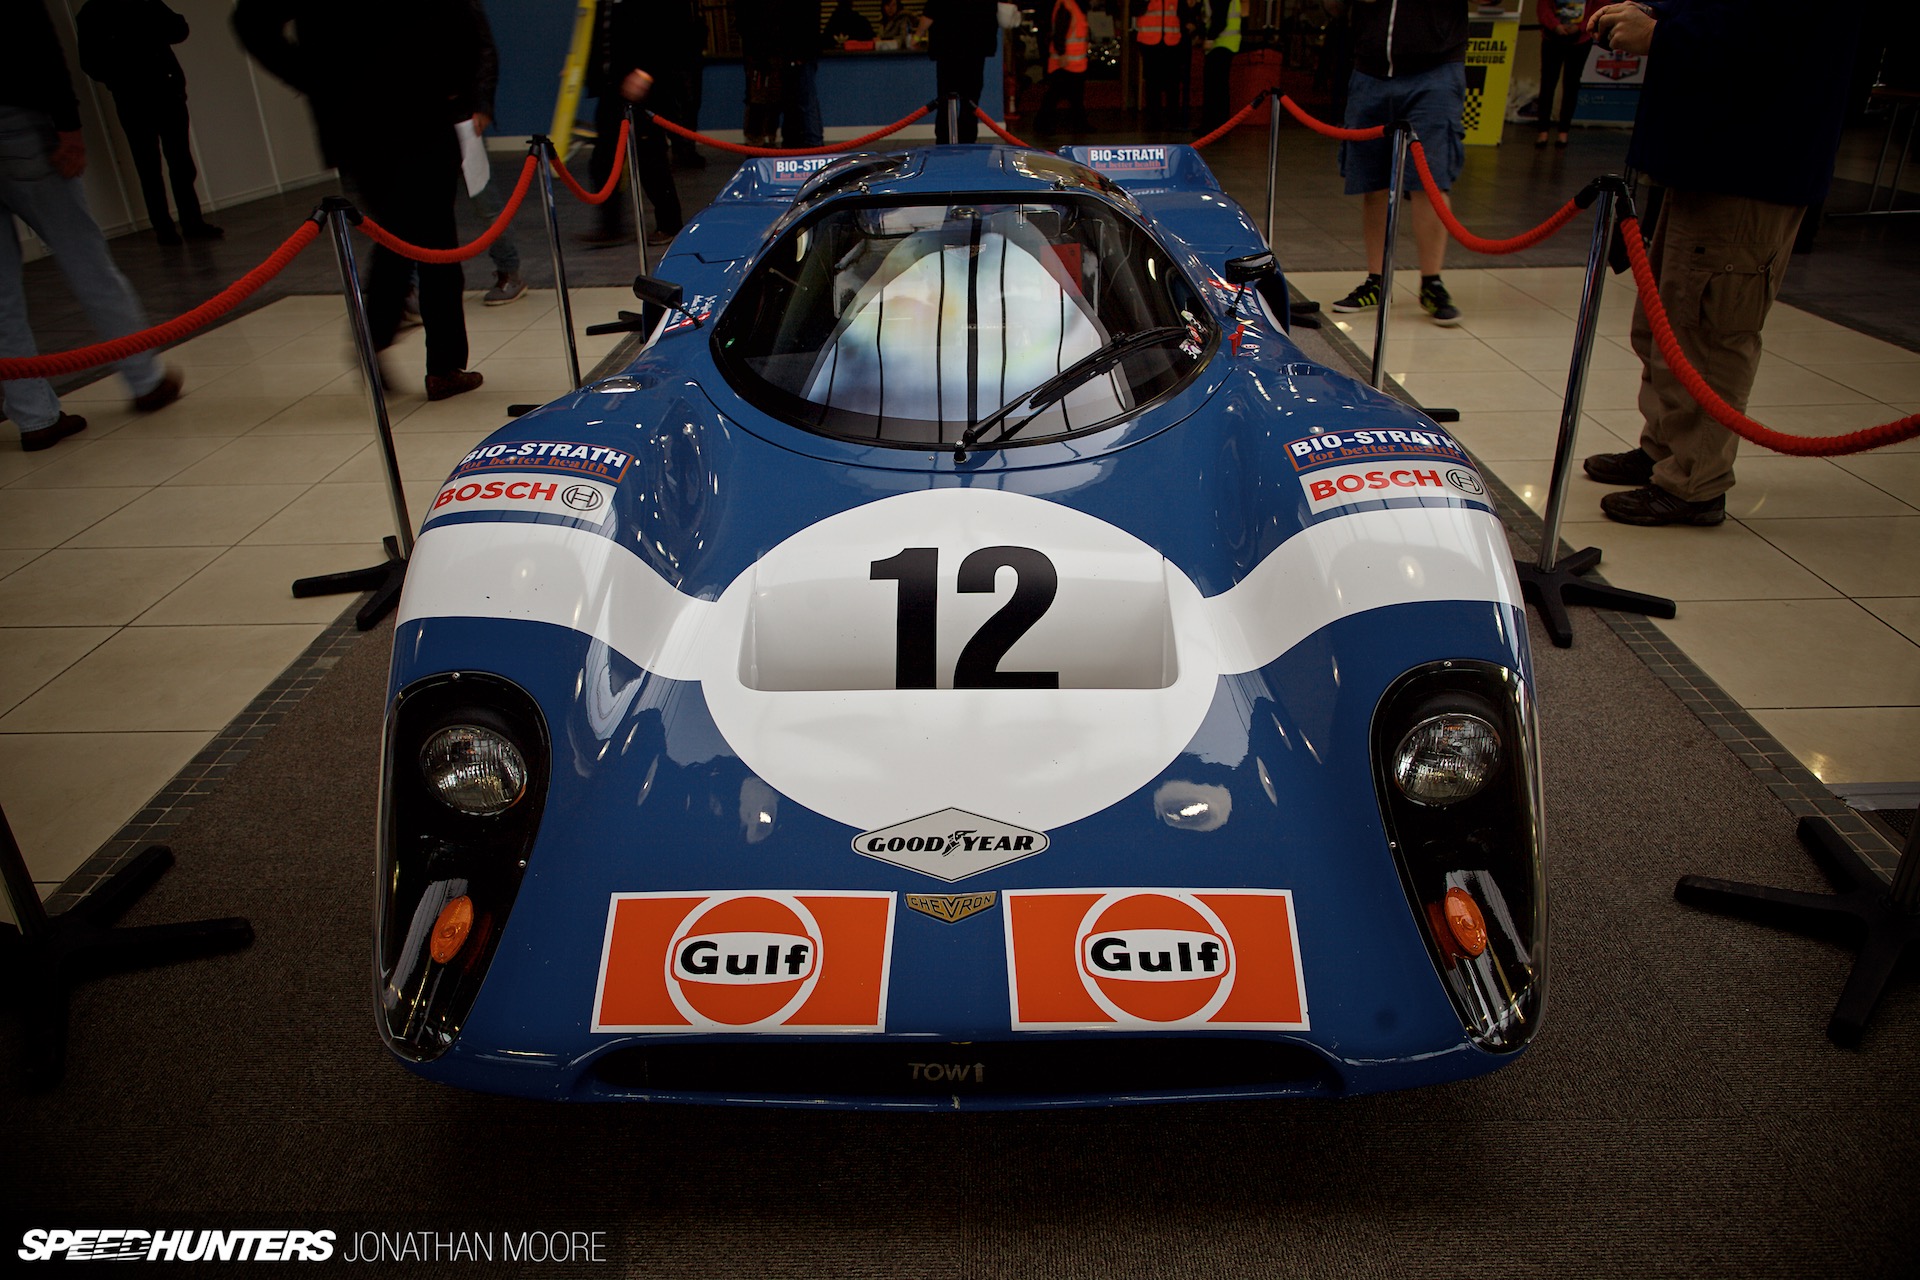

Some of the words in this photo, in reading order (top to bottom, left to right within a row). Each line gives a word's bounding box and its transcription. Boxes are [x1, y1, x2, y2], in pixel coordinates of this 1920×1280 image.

[1466, 40, 1507, 51] FICIAL
[1467, 55, 1506, 64] WGUIDE
[1090, 148, 1165, 161] BIO-STRATH
[1109, 161, 1133, 169] better
[1135, 160, 1161, 168] health
[459, 442, 627, 469] BIO-STRATH
[1290, 430, 1463, 457] BIO-STRATH
[1307, 451, 1337, 464] for
[1339, 444, 1396, 457] better
[1398, 443, 1461, 459] health
[460, 459, 486, 472] for
[489, 455, 545, 468] better
[547, 456, 609, 476] health
[433, 481, 559, 511] BOSCH
[1309, 469, 1443, 501] BOSCH
[869, 545, 1060, 690] 12
[911, 894, 993, 919] CHEVRON
[680, 940, 809, 975] Gulf
[1090, 937, 1220, 972] Gulf
[907, 1062, 971, 1081] TOW
